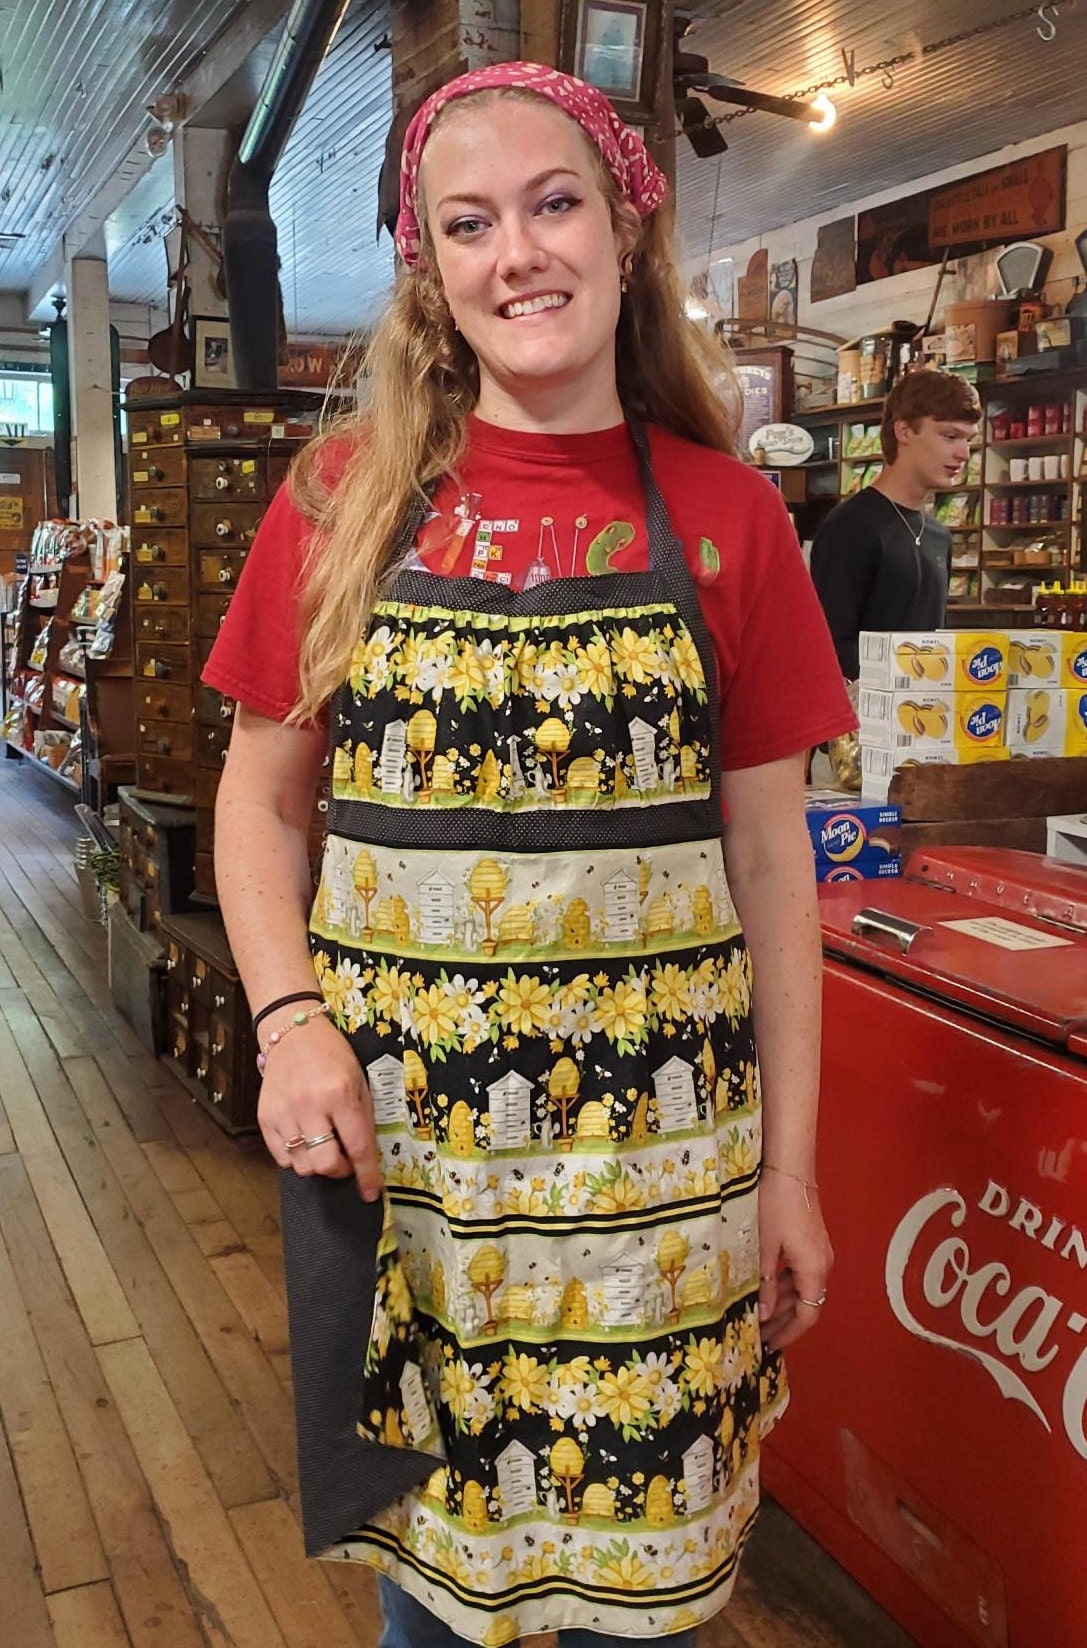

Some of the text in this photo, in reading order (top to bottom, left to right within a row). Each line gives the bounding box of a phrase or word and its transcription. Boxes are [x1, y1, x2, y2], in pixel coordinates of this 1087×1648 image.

[983, 214, 998, 229] BY
[1000, 209, 1019, 226] ALL
[0, 422, 28, 438] XIT
[821, 821, 850, 844] Moon
[840, 830, 857, 847] Pie
[885, 1187, 1087, 1460] Coca-
